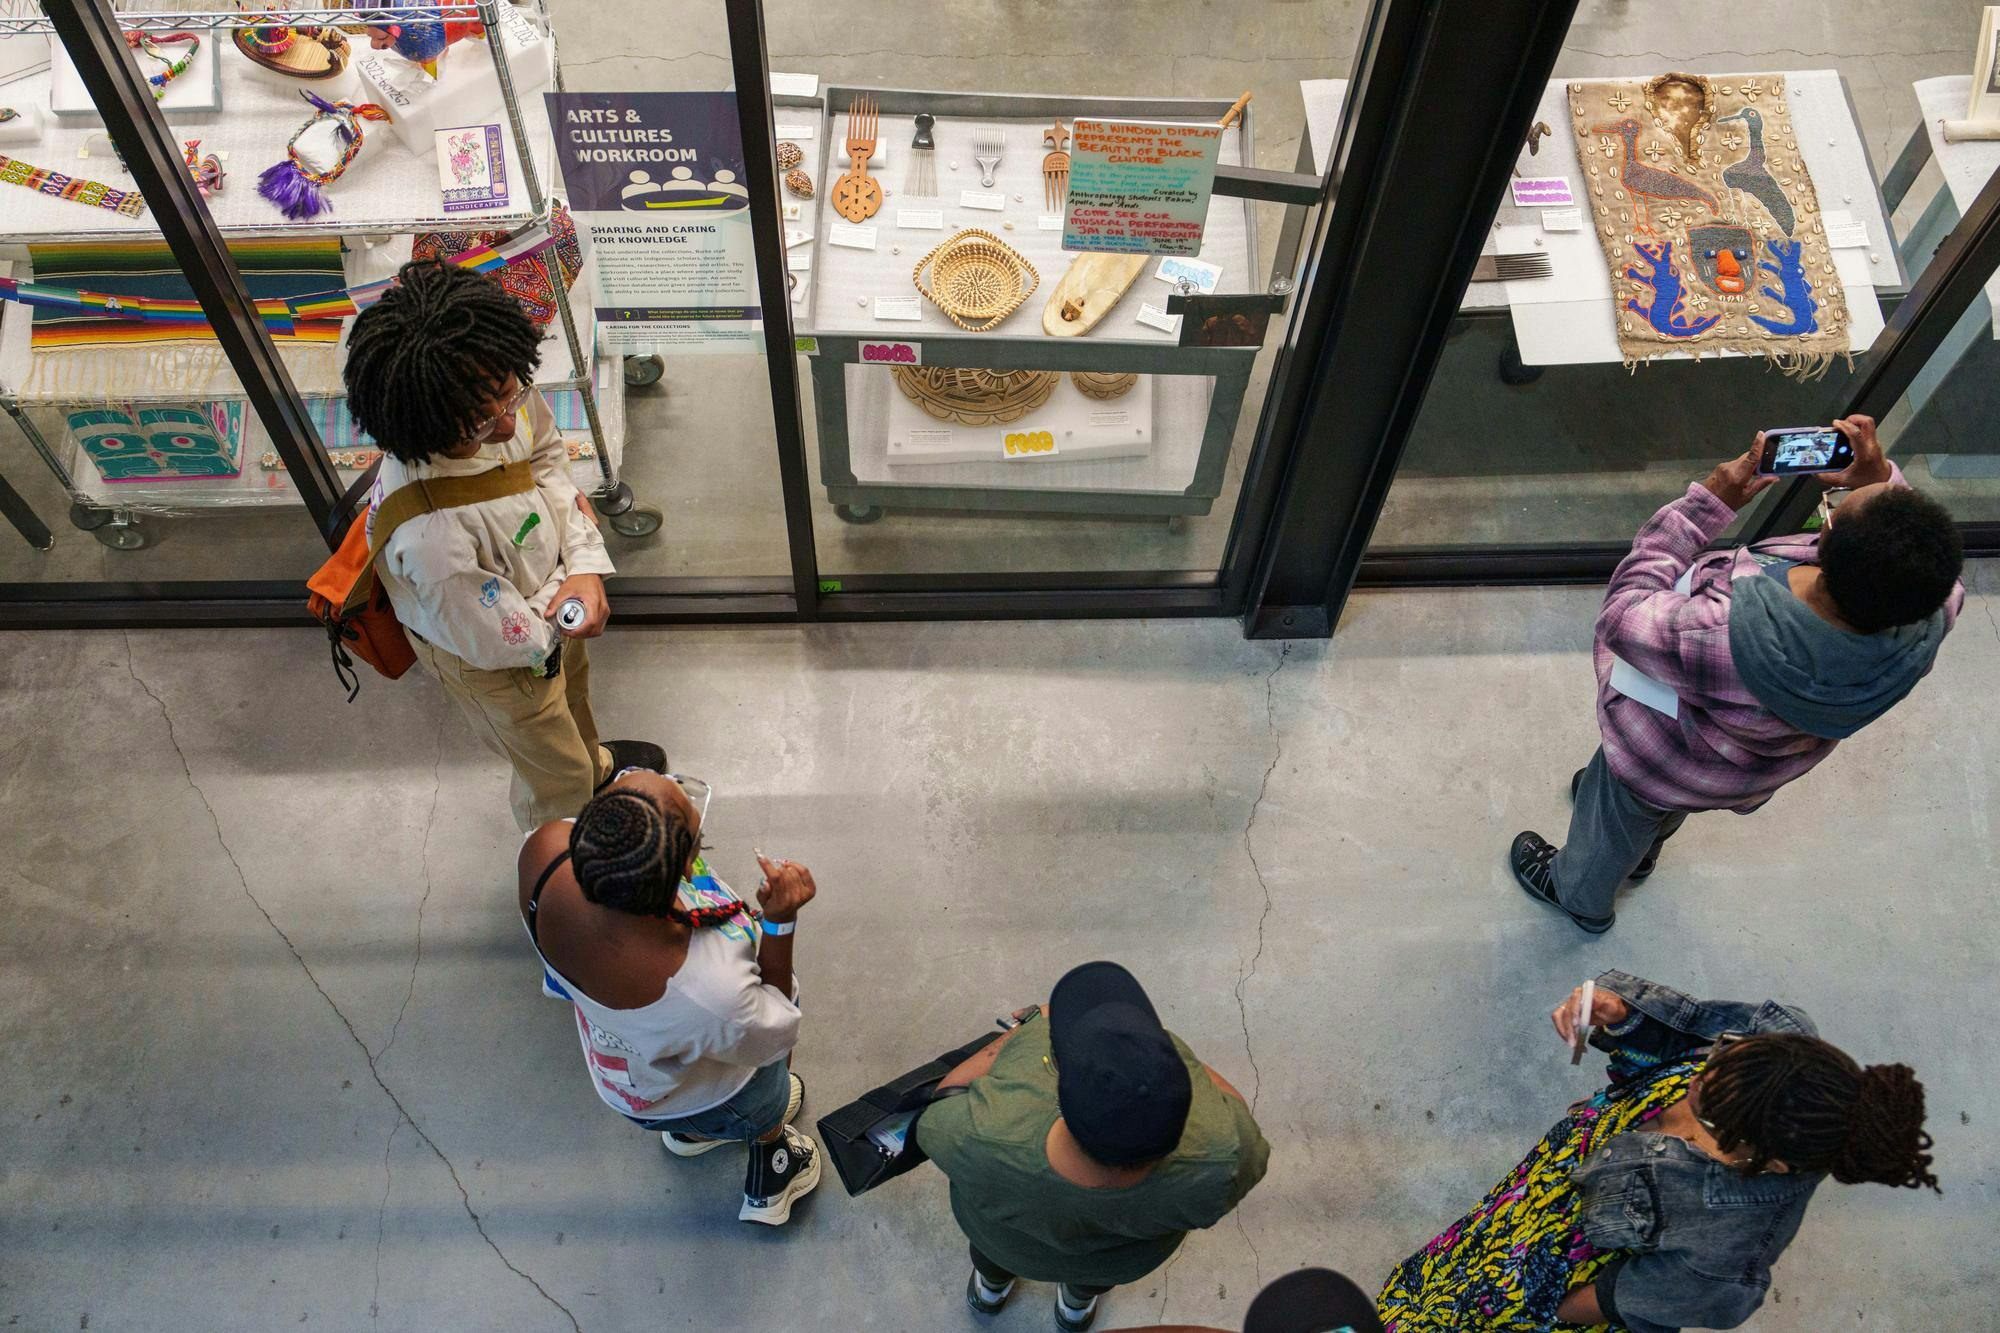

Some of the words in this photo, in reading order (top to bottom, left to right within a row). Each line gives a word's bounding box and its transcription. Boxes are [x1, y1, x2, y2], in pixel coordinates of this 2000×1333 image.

[566, 109, 619, 123] ARTS
[625, 109, 642, 123] &
[570, 129, 673, 143] CULTURES
[1073, 122, 1104, 133] THIS
[1110, 124, 1162, 135] WINDOW
[1166, 128, 1219, 138] DISPLAY
[1075, 133, 1154, 146] REPRESENTS
[1158, 137, 1182, 147] THE
[576, 148, 698, 162] WORKROOM
[1077, 142, 1131, 156] BEAUTY
[1137, 148, 1153, 156] OF
[1157, 148, 1204, 159] BLACK
[449, 201, 504, 211] HANDICRAFTS
[1074, 208, 1109, 217] COME
[1115, 211, 1139, 219] SEE
[1071, 217, 1125, 226] MUSICAL
[590, 226, 642, 234] SHARING
[645, 226, 669, 234] AND
[672, 225, 716, 233] CARING
[593, 236, 615, 244] FOR
[618, 236, 688, 244] KNOWLEDGE
